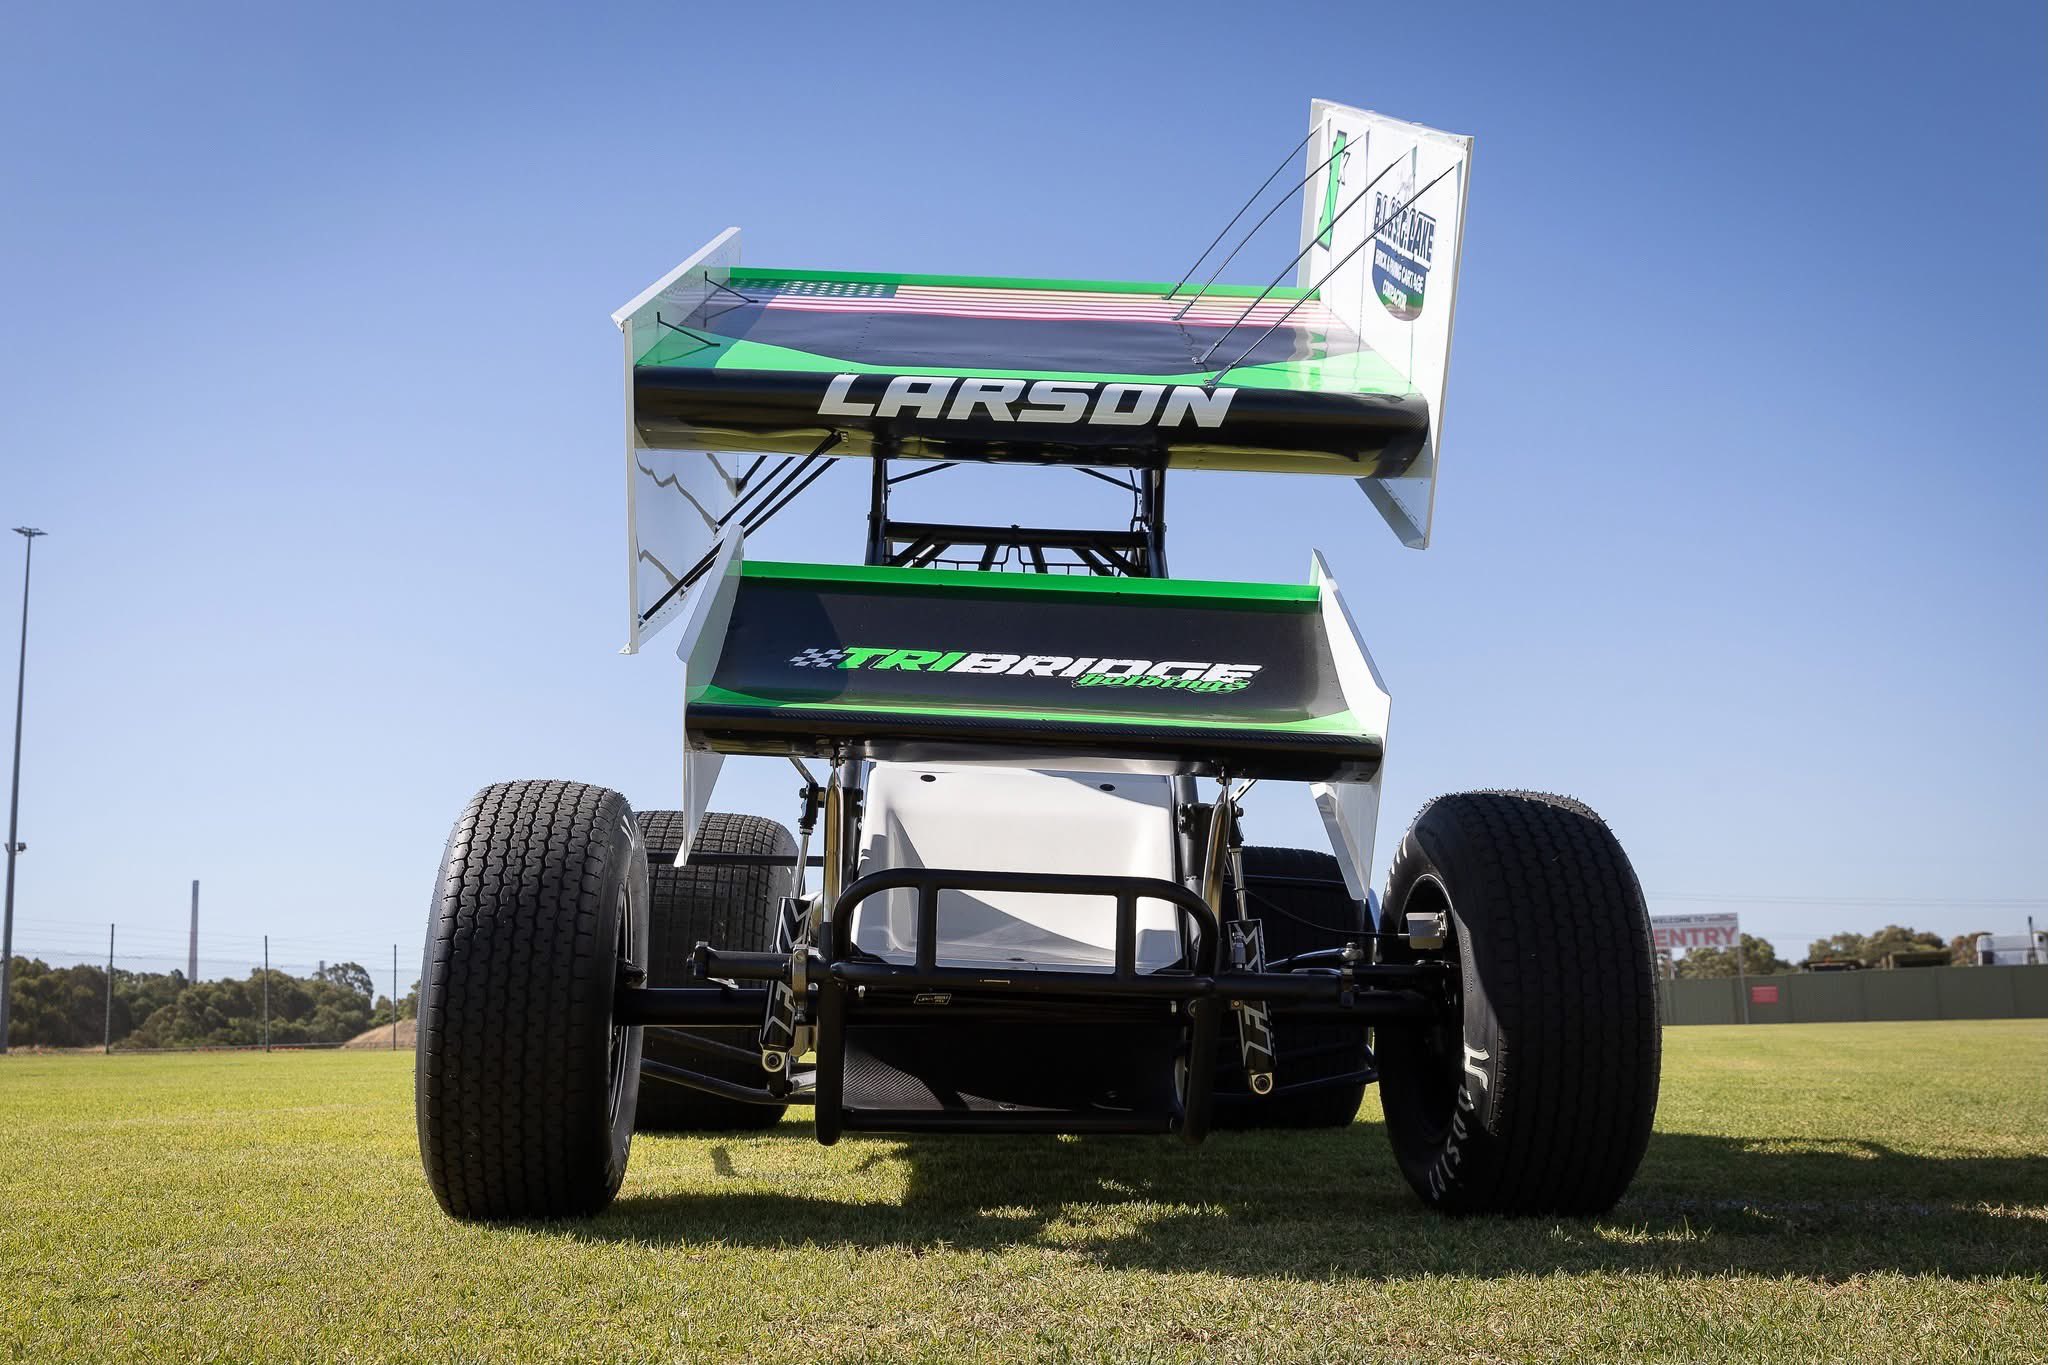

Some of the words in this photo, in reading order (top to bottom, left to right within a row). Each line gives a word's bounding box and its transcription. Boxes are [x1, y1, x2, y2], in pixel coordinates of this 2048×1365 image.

[817, 373, 1238, 428] LARSON
[841, 646, 1263, 683] TRIBRIDGE
[1654, 927, 1735, 946] ENTRY
